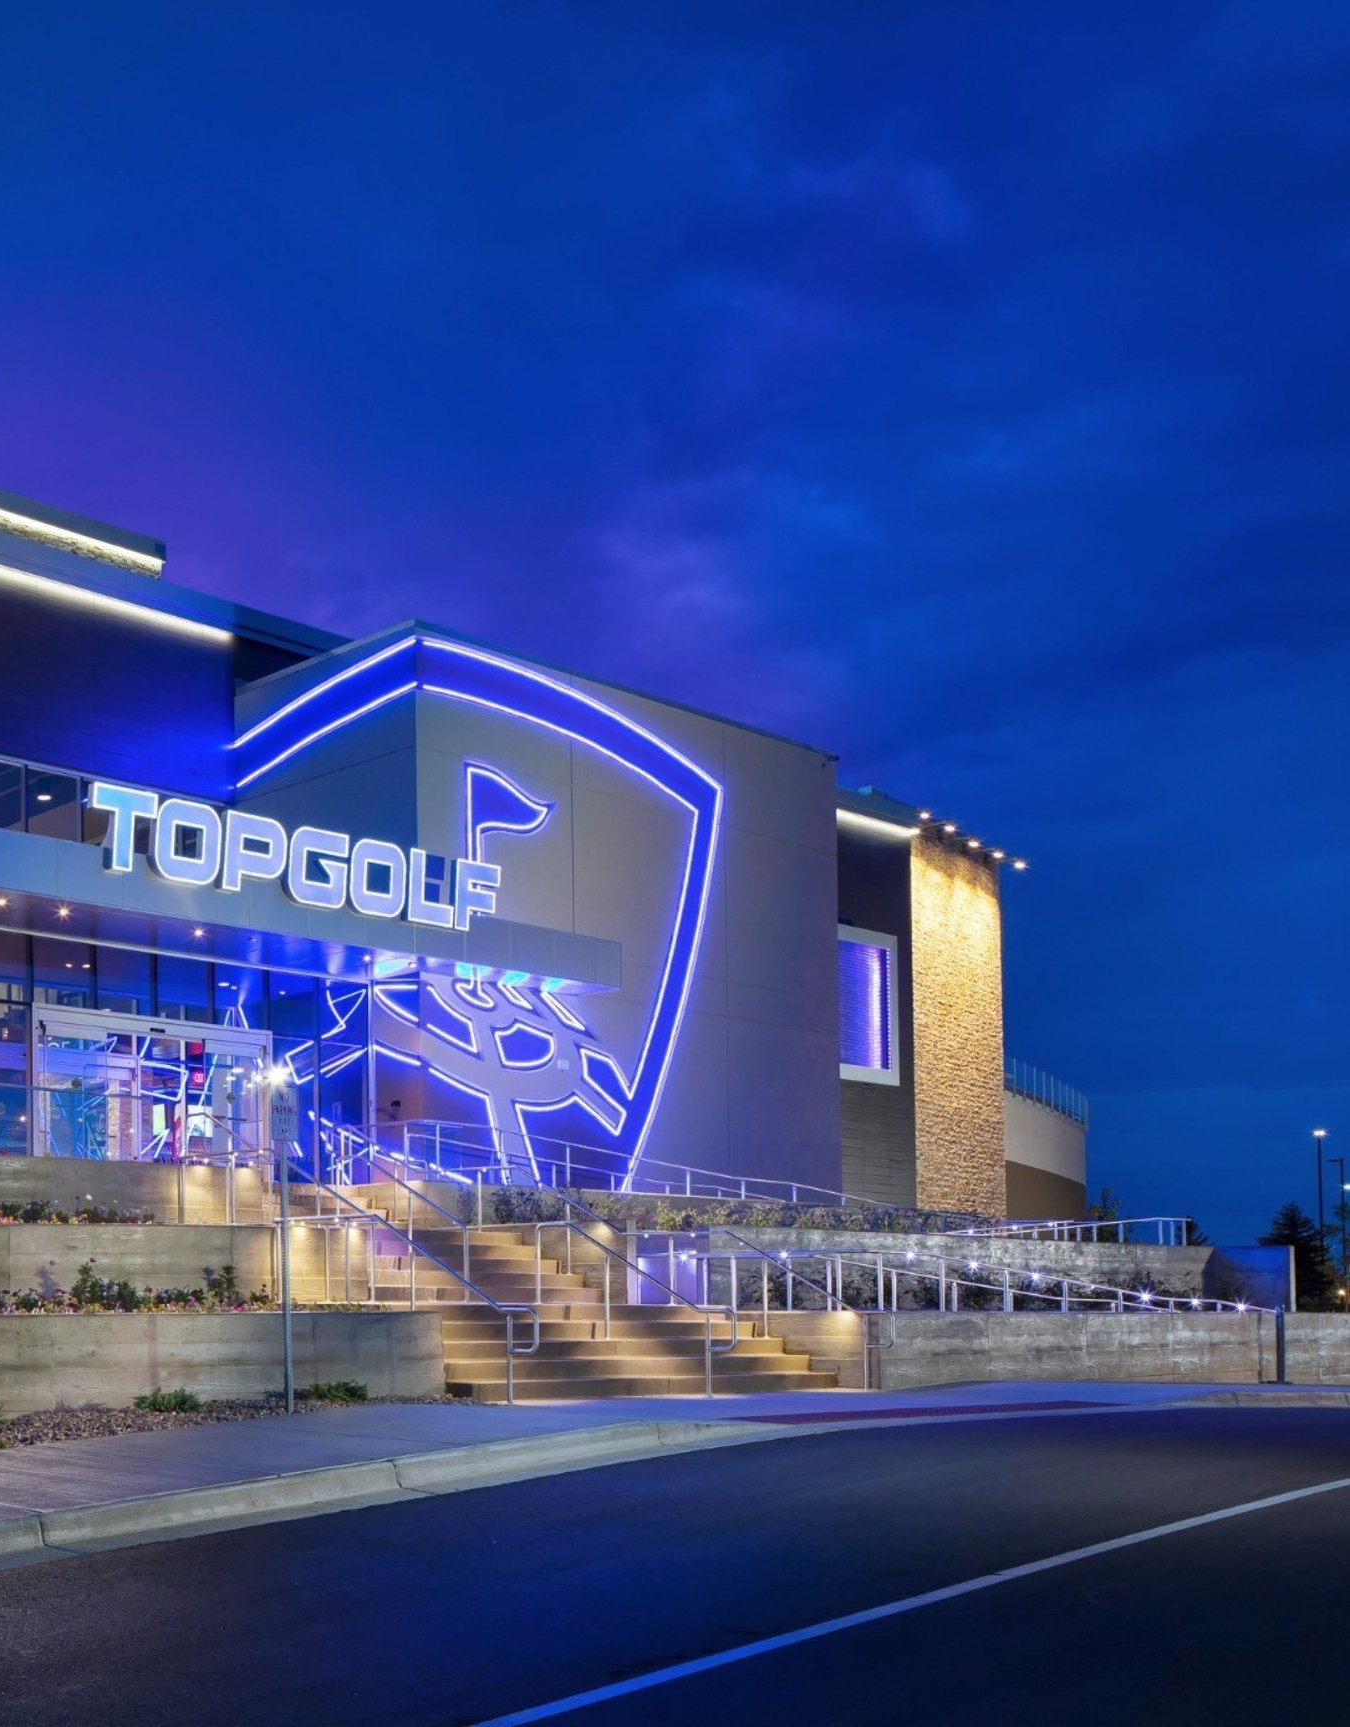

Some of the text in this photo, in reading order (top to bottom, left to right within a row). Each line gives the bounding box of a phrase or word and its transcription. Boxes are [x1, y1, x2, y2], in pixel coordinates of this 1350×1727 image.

[91, 781, 501, 931] TOPGOLF
[279, 1092, 290, 1103] NO
[272, 1105, 297, 1115] PARKING
